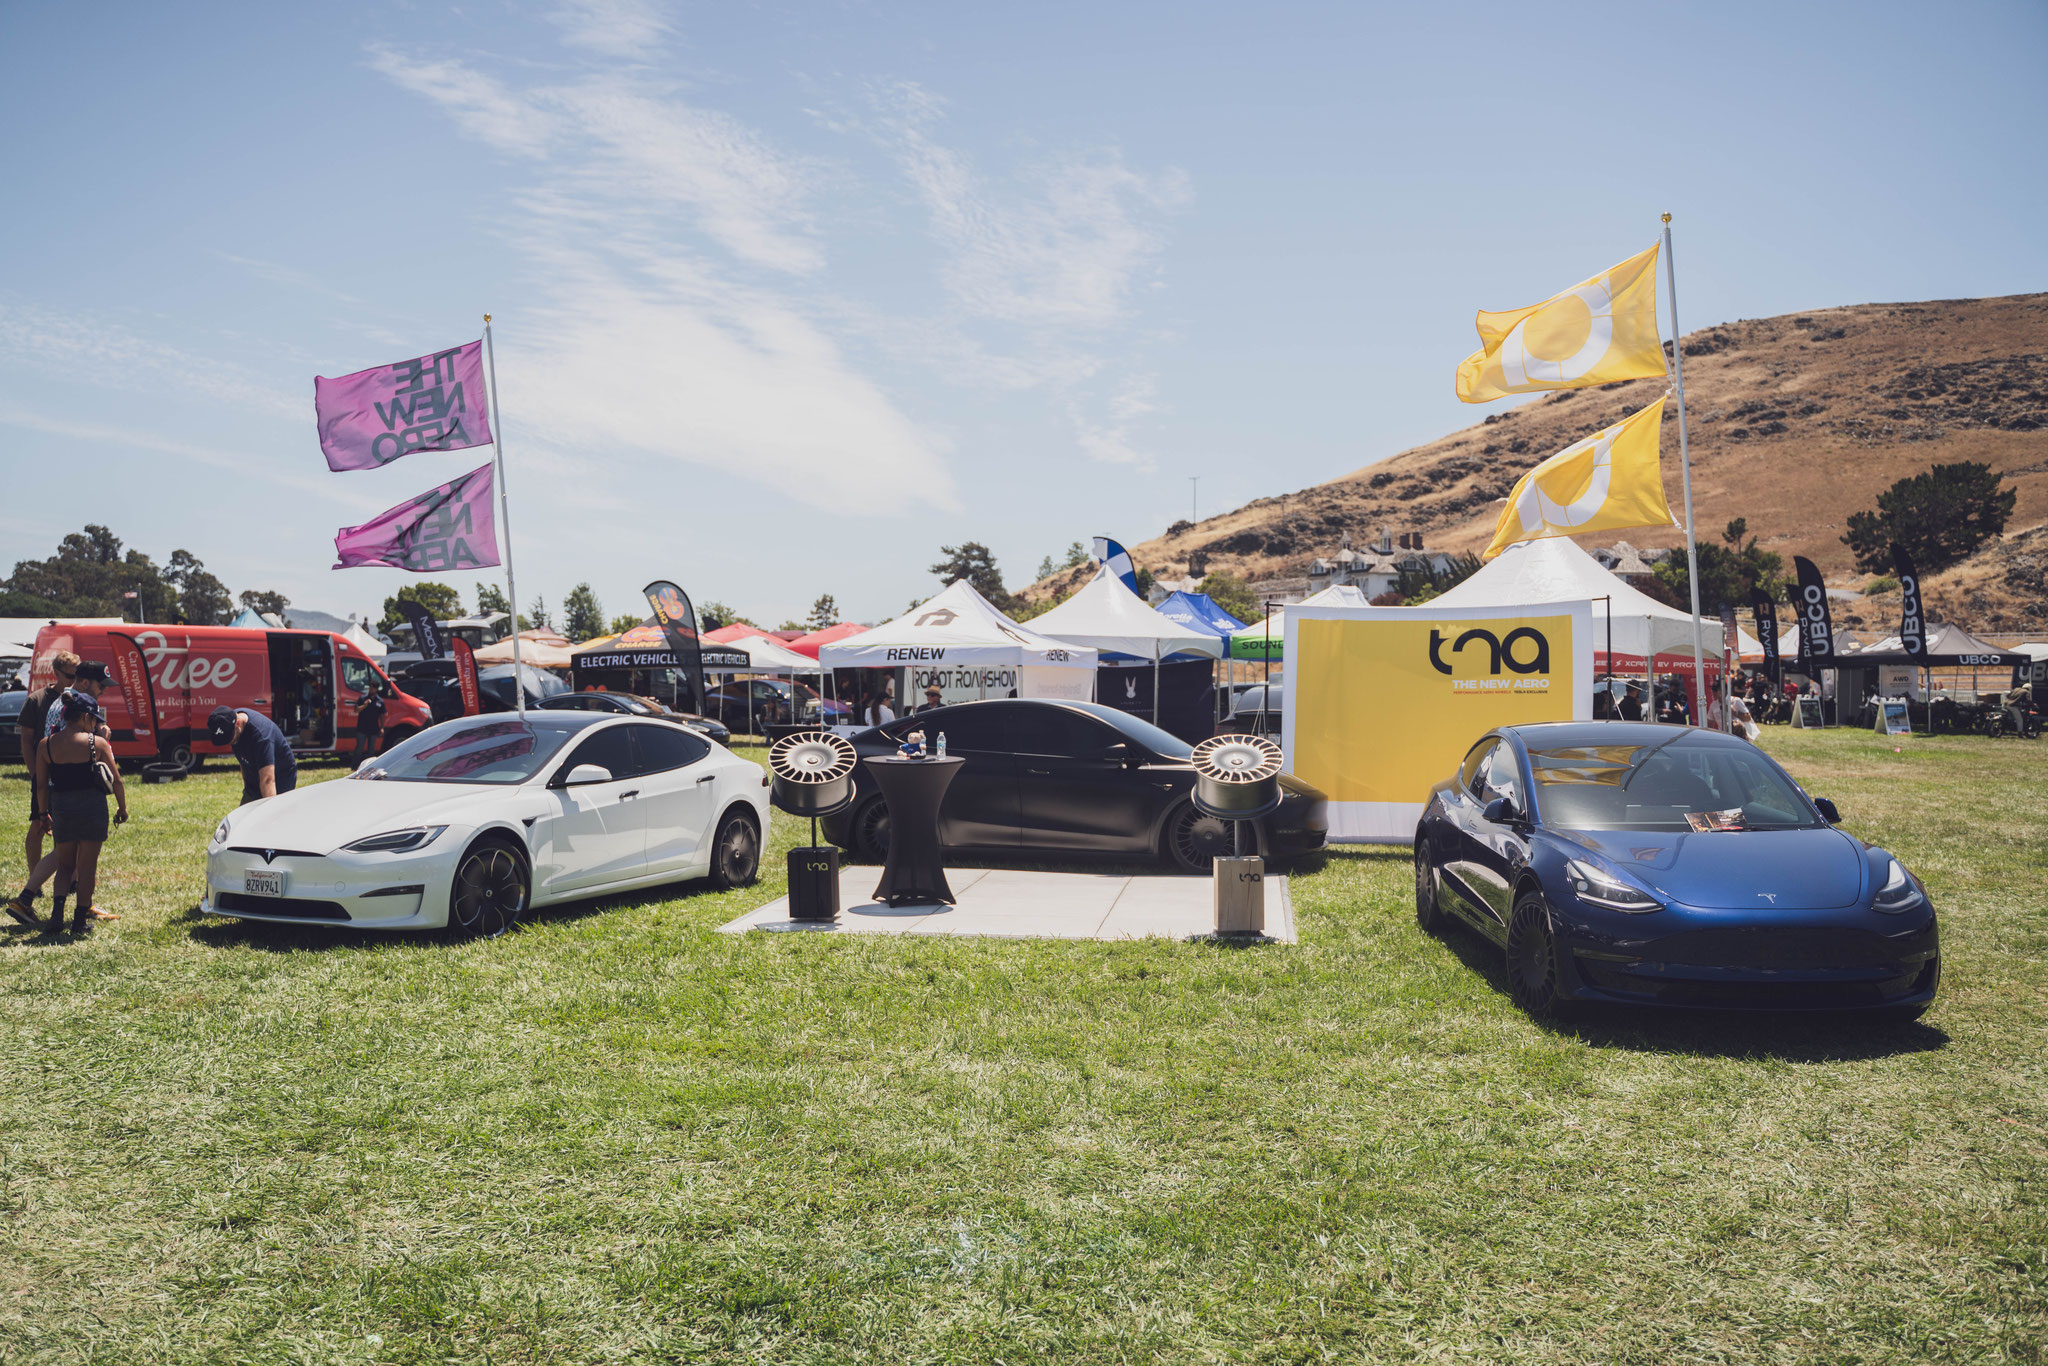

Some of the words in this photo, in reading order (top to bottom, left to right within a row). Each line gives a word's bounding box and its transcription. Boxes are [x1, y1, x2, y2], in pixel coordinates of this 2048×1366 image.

[1804, 585, 1829, 655] UBCO
[1902, 575, 1921, 654] UBCO
[128, 650, 139, 668] Car
[580, 655, 631, 668] ELECTRIC
[633, 653, 680, 665] VEHICLE
[701, 653, 723, 664] ELECTRIC
[724, 653, 748, 665] VEHICLES
[887, 648, 946, 660] RENEW
[1046, 649, 1069, 662] RENEW
[1959, 655, 2001, 665] UBCO
[1673, 661, 1728, 669] PROTCTION
[2019, 662, 2048, 681] UB
[131, 669, 144, 697] repair
[463, 667, 473, 690] repair
[915, 671, 953, 689] ROOT
[956, 670, 1017, 689] ROASHOW
[1452, 680, 1477, 690] THE
[1480, 679, 1511, 689] NEW
[1513, 678, 1550, 688] AERO
[198, 696, 216, 705] You
[467, 691, 475, 707] that
[137, 698, 147, 717] that
[246, 879, 279, 894] 8ZRV941
